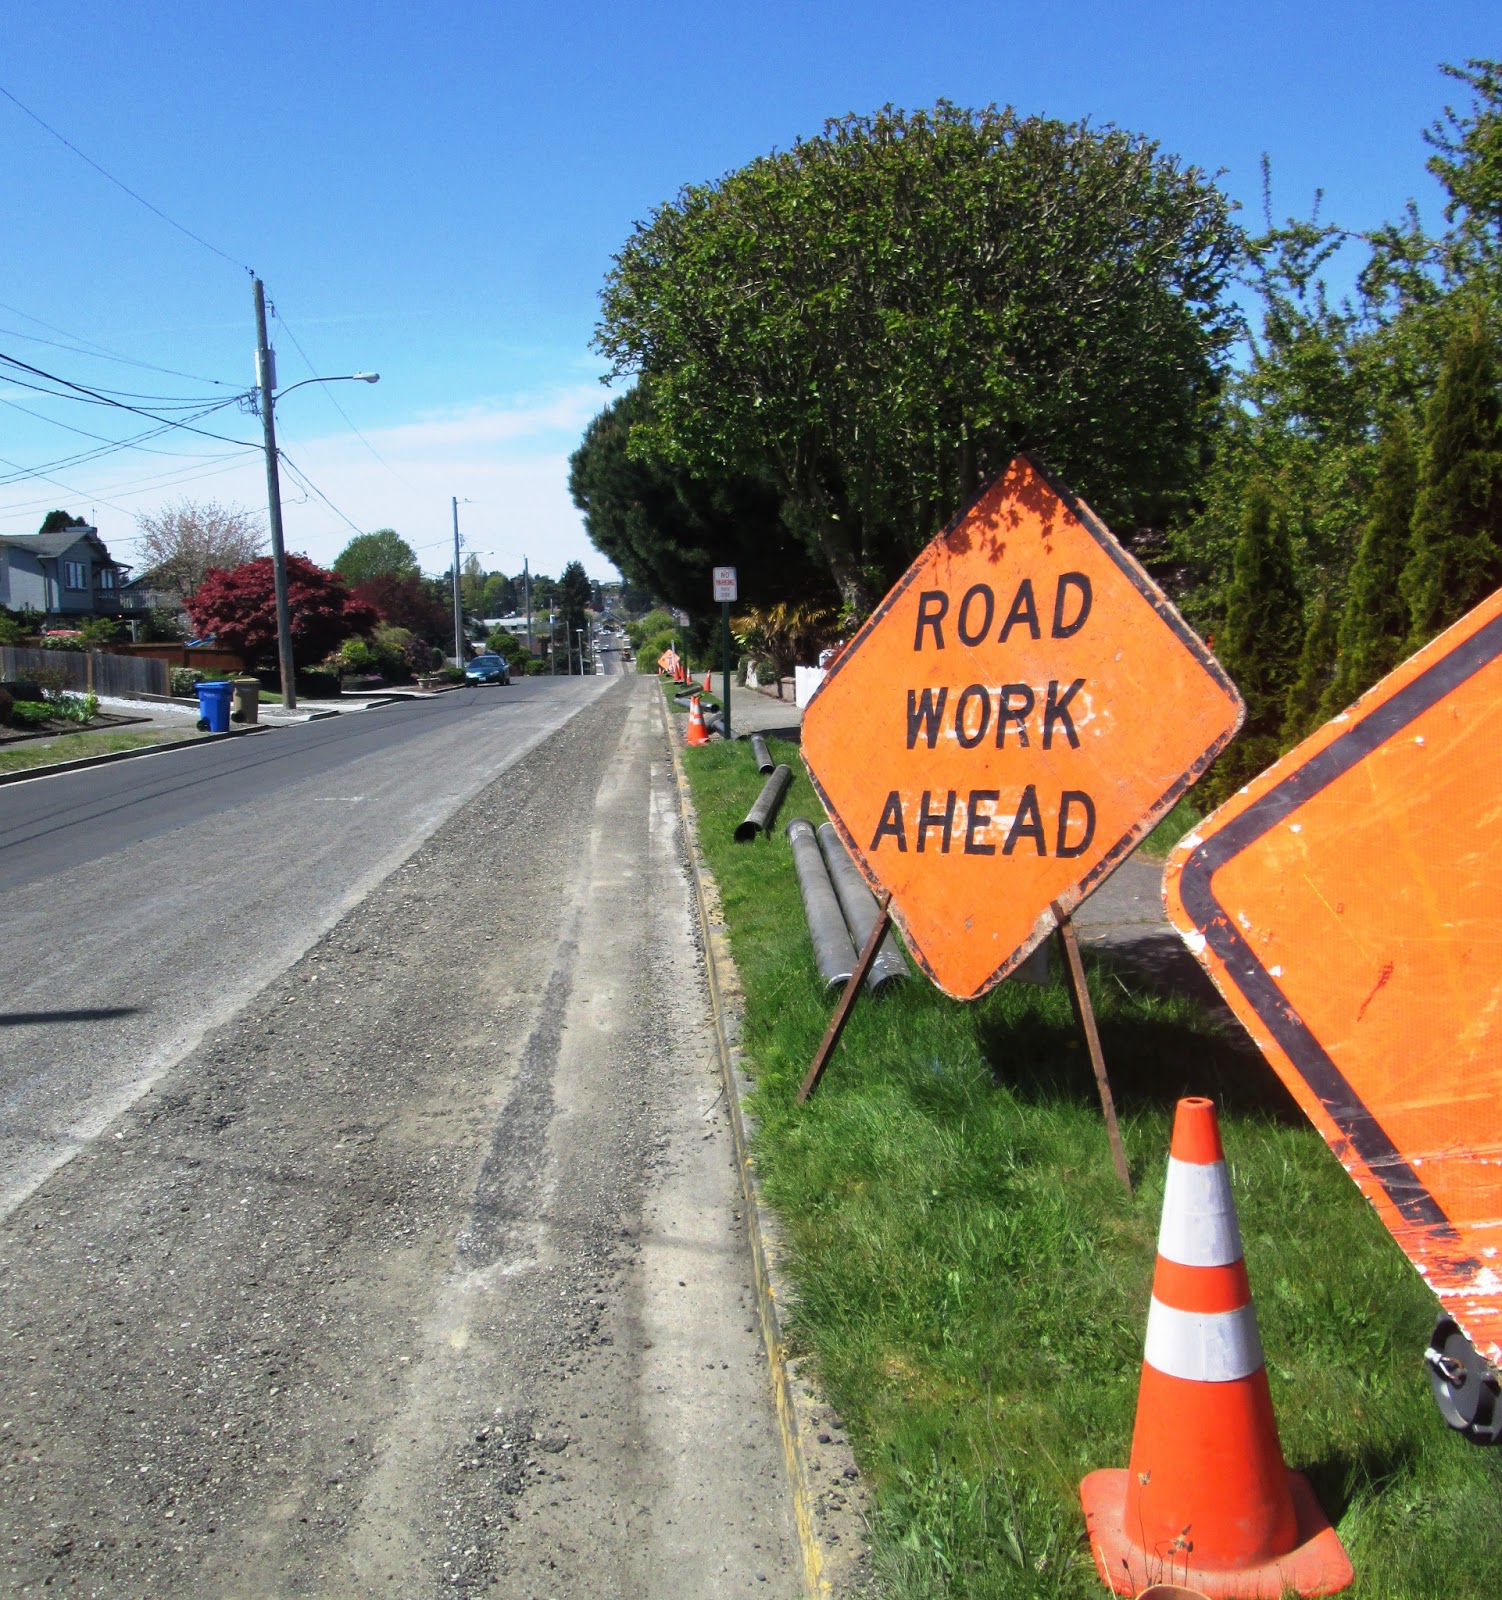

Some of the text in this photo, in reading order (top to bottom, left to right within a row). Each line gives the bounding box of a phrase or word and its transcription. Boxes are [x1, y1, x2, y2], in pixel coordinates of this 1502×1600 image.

[914, 571, 1093, 651] ROAD
[906, 678, 1087, 749] WORK
[870, 784, 1097, 858] AHEAD
